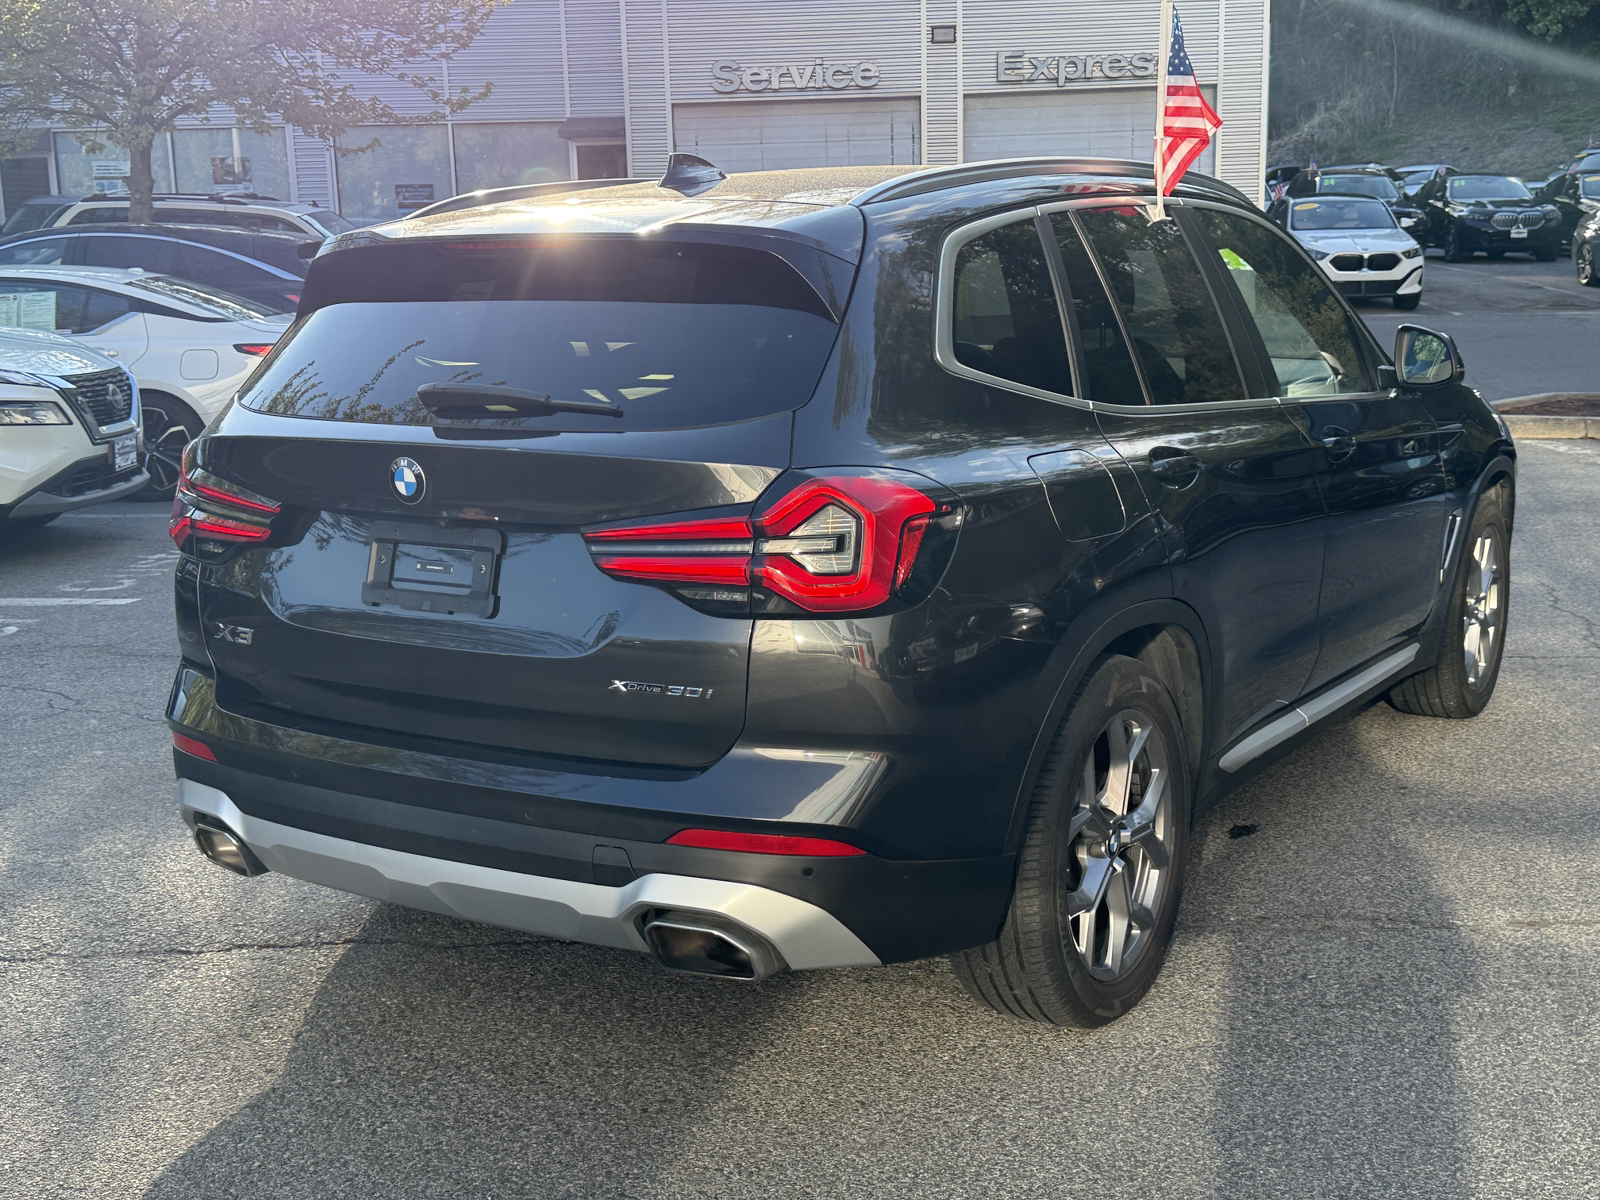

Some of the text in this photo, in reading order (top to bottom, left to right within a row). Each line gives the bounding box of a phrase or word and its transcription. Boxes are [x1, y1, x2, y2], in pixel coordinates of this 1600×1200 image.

[711, 50, 1158, 93] Service Expres
[213, 621, 254, 645] X3
